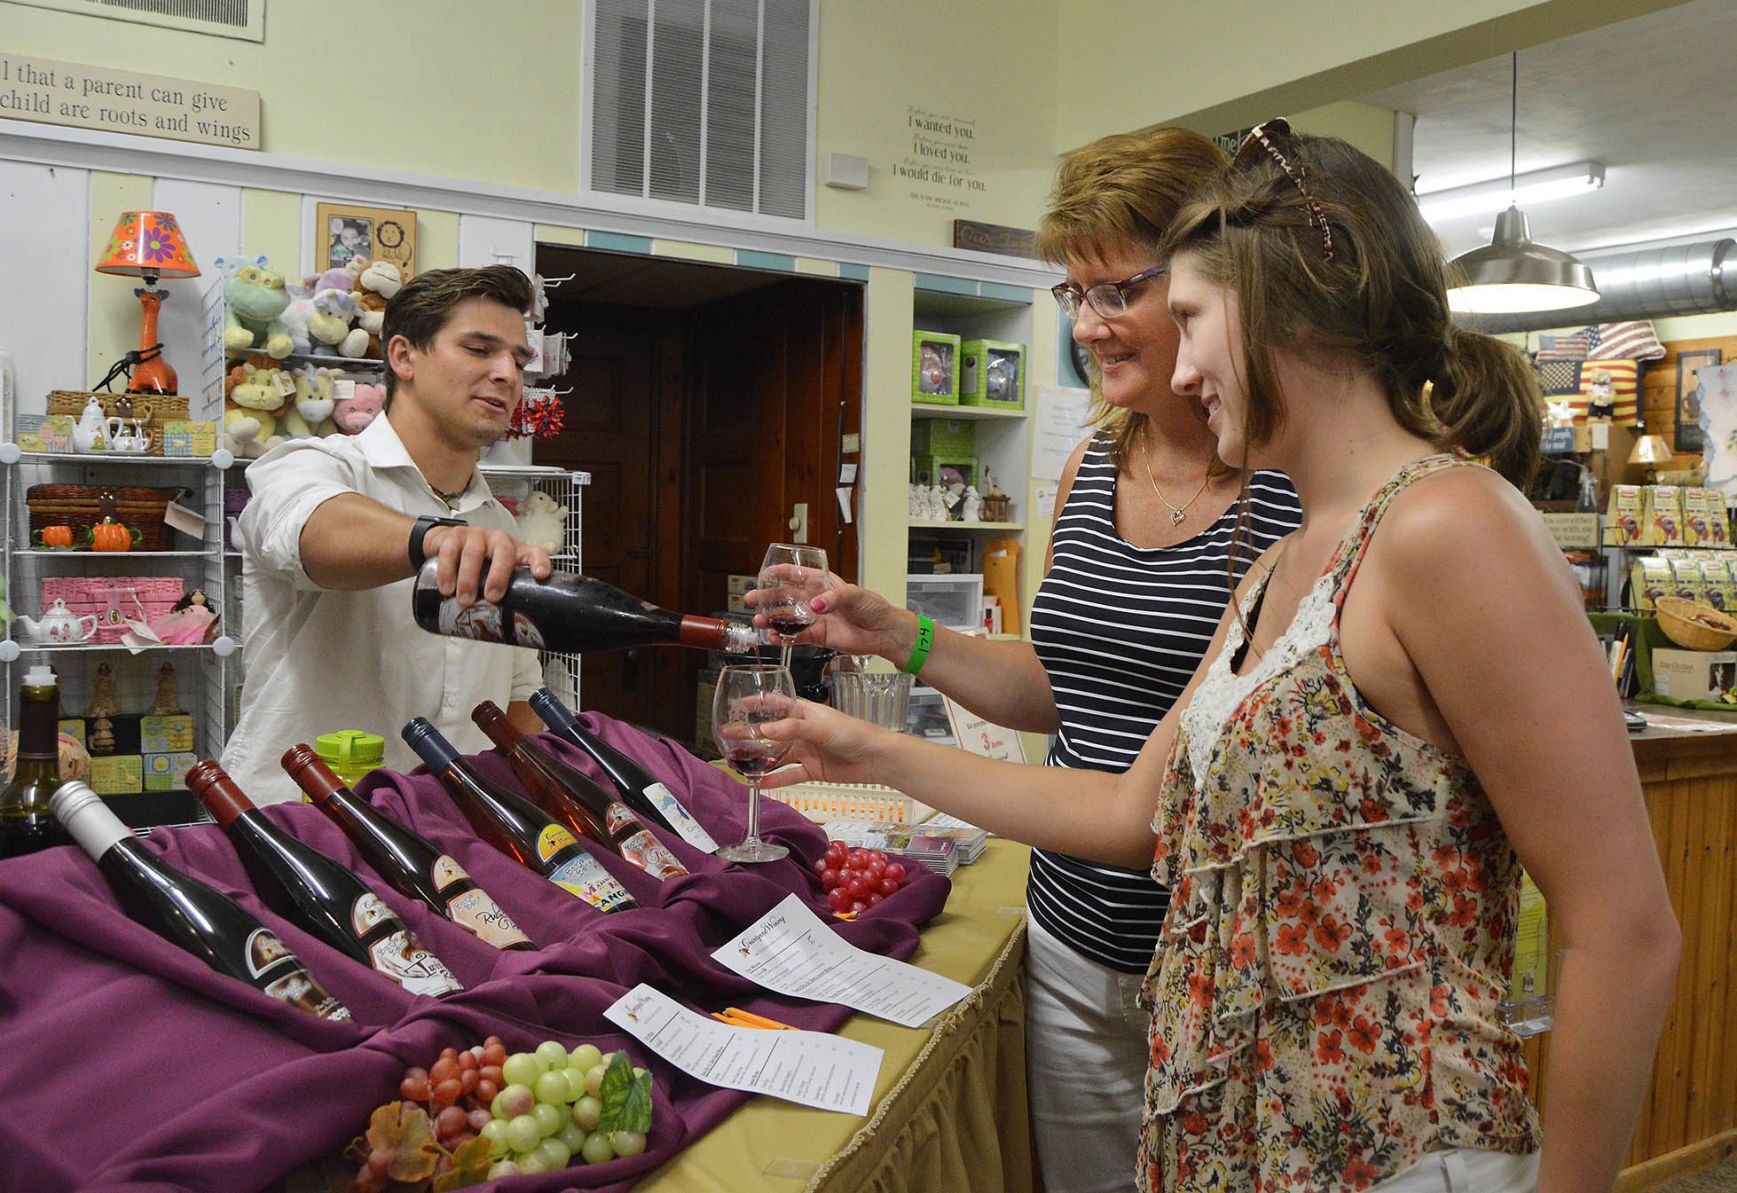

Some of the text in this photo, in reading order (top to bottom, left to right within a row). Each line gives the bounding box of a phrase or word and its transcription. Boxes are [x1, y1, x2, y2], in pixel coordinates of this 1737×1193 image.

[17, 63, 57, 87] that
[65, 75, 75, 90] a
[83, 78, 144, 99] parent
[151, 88, 184, 105] can
[192, 92, 229, 112] give
[0, 90, 250, 144] child are roots and wings
[908, 115, 913, 127] I
[915, 117, 951, 135] wanted
[954, 127, 975, 139] you.
[913, 142, 918, 154] I
[920, 143, 947, 159] loved
[949, 151, 970, 164] you.
[893, 164, 898, 176] I
[899, 166, 929, 182] would
[931, 172, 946, 184] die
[949, 174, 964, 188] for
[966, 179, 987, 192] you.
[919, 628, 931, 654] 174
